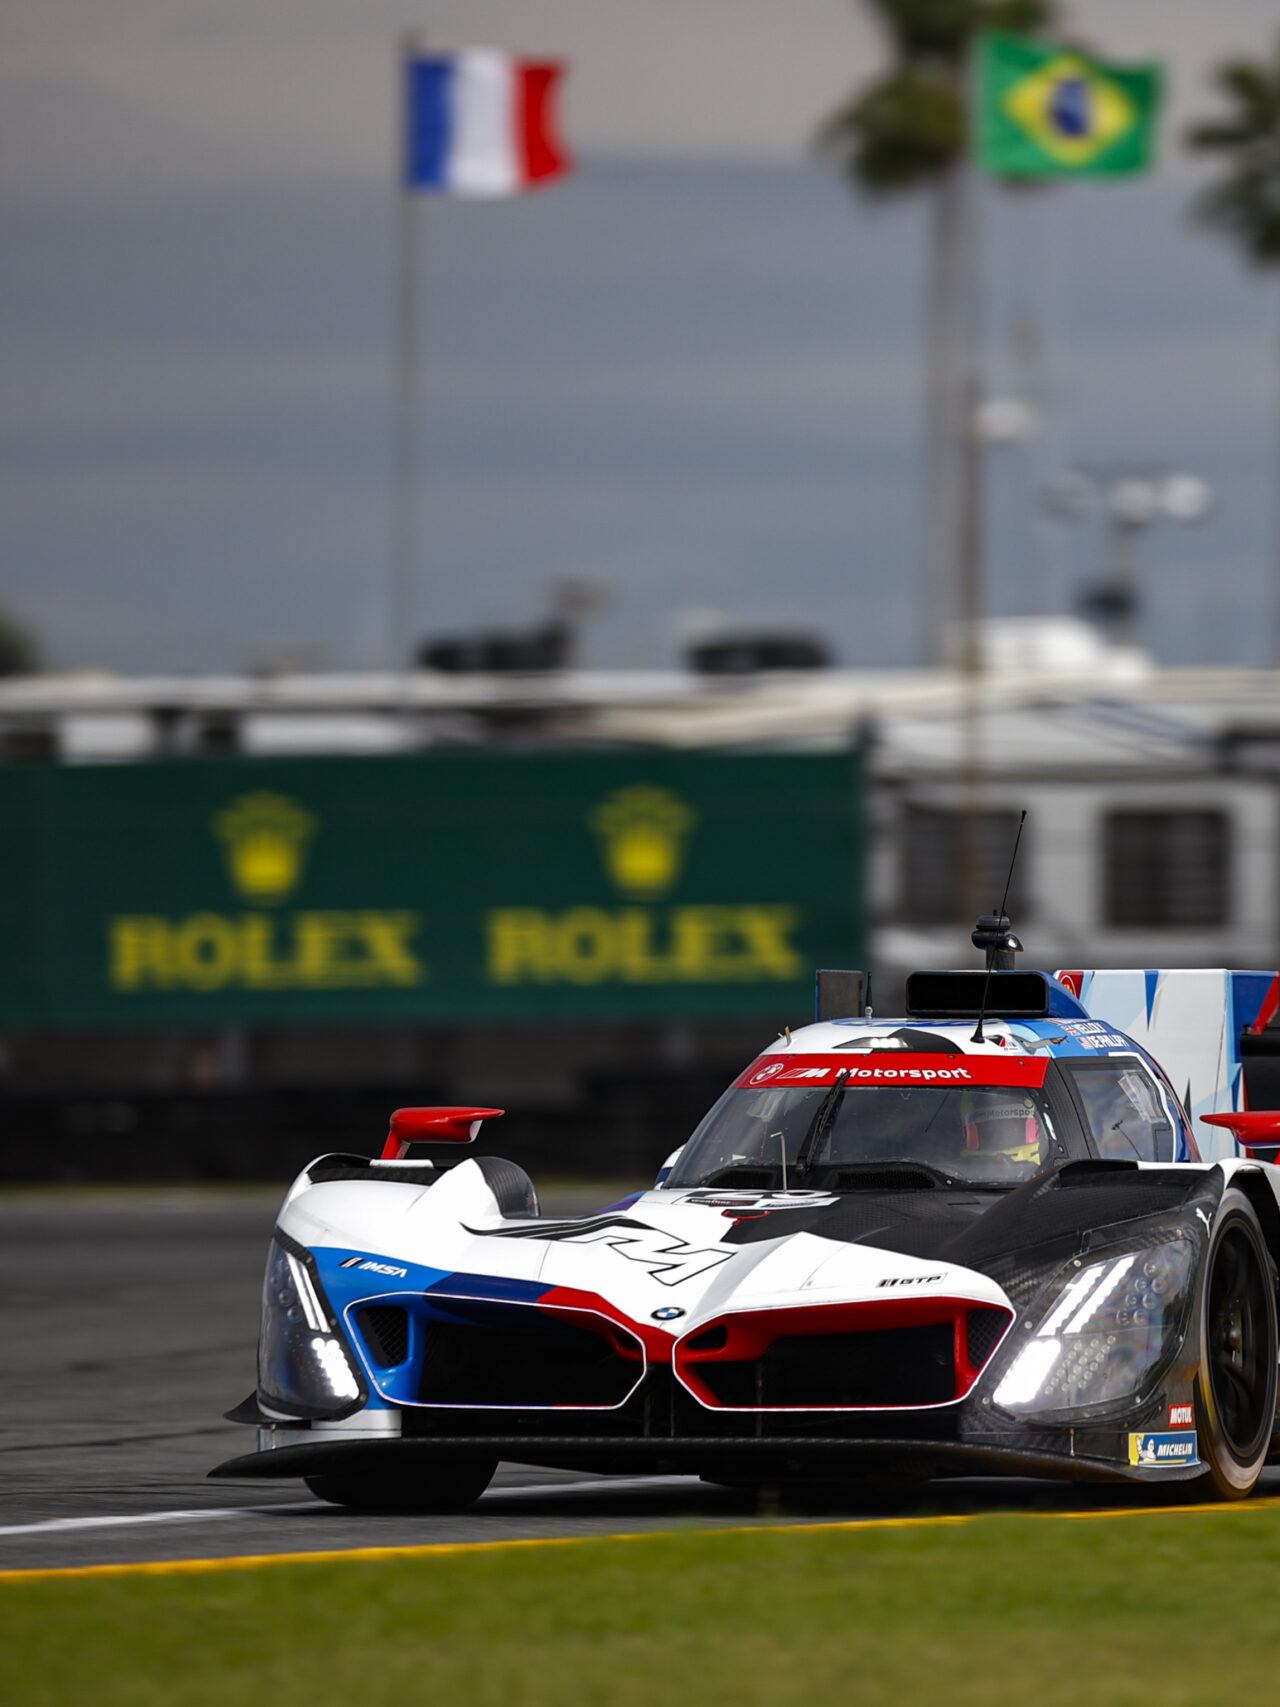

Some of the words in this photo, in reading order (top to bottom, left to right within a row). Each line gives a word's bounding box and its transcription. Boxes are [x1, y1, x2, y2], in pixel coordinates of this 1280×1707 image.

[111, 911, 422, 992] ROLEX
[488, 904, 801, 986] ROLEX
[835, 1067, 972, 1080] Motorsport
[357, 1261, 409, 1278] IMSA
[899, 1275, 942, 1285] GTP
[1170, 1406, 1192, 1425] MOTUL
[1157, 1442, 1193, 1457] MICHELIN
